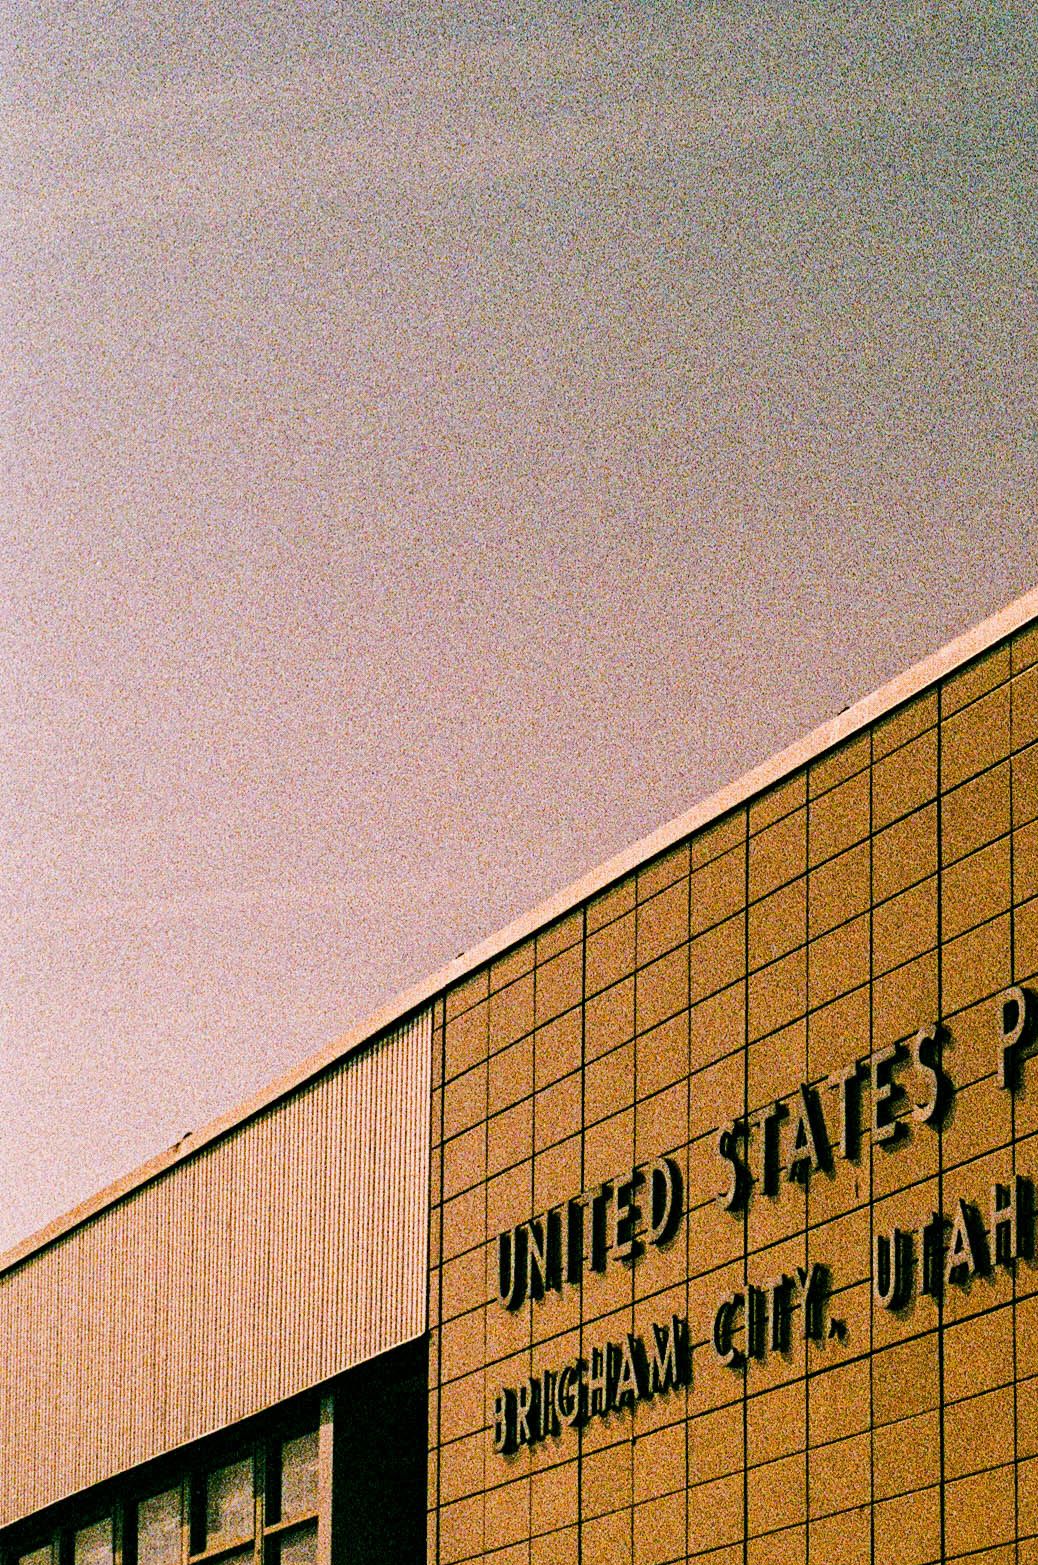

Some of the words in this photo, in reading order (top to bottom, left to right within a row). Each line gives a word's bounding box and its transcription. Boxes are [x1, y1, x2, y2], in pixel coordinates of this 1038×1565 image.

[497, 1156, 680, 1308] UNITED
[718, 1023, 946, 1210] STATES
[494, 1314, 690, 1454] BRIGHAM
[872, 1174, 1025, 1310] UTAH
